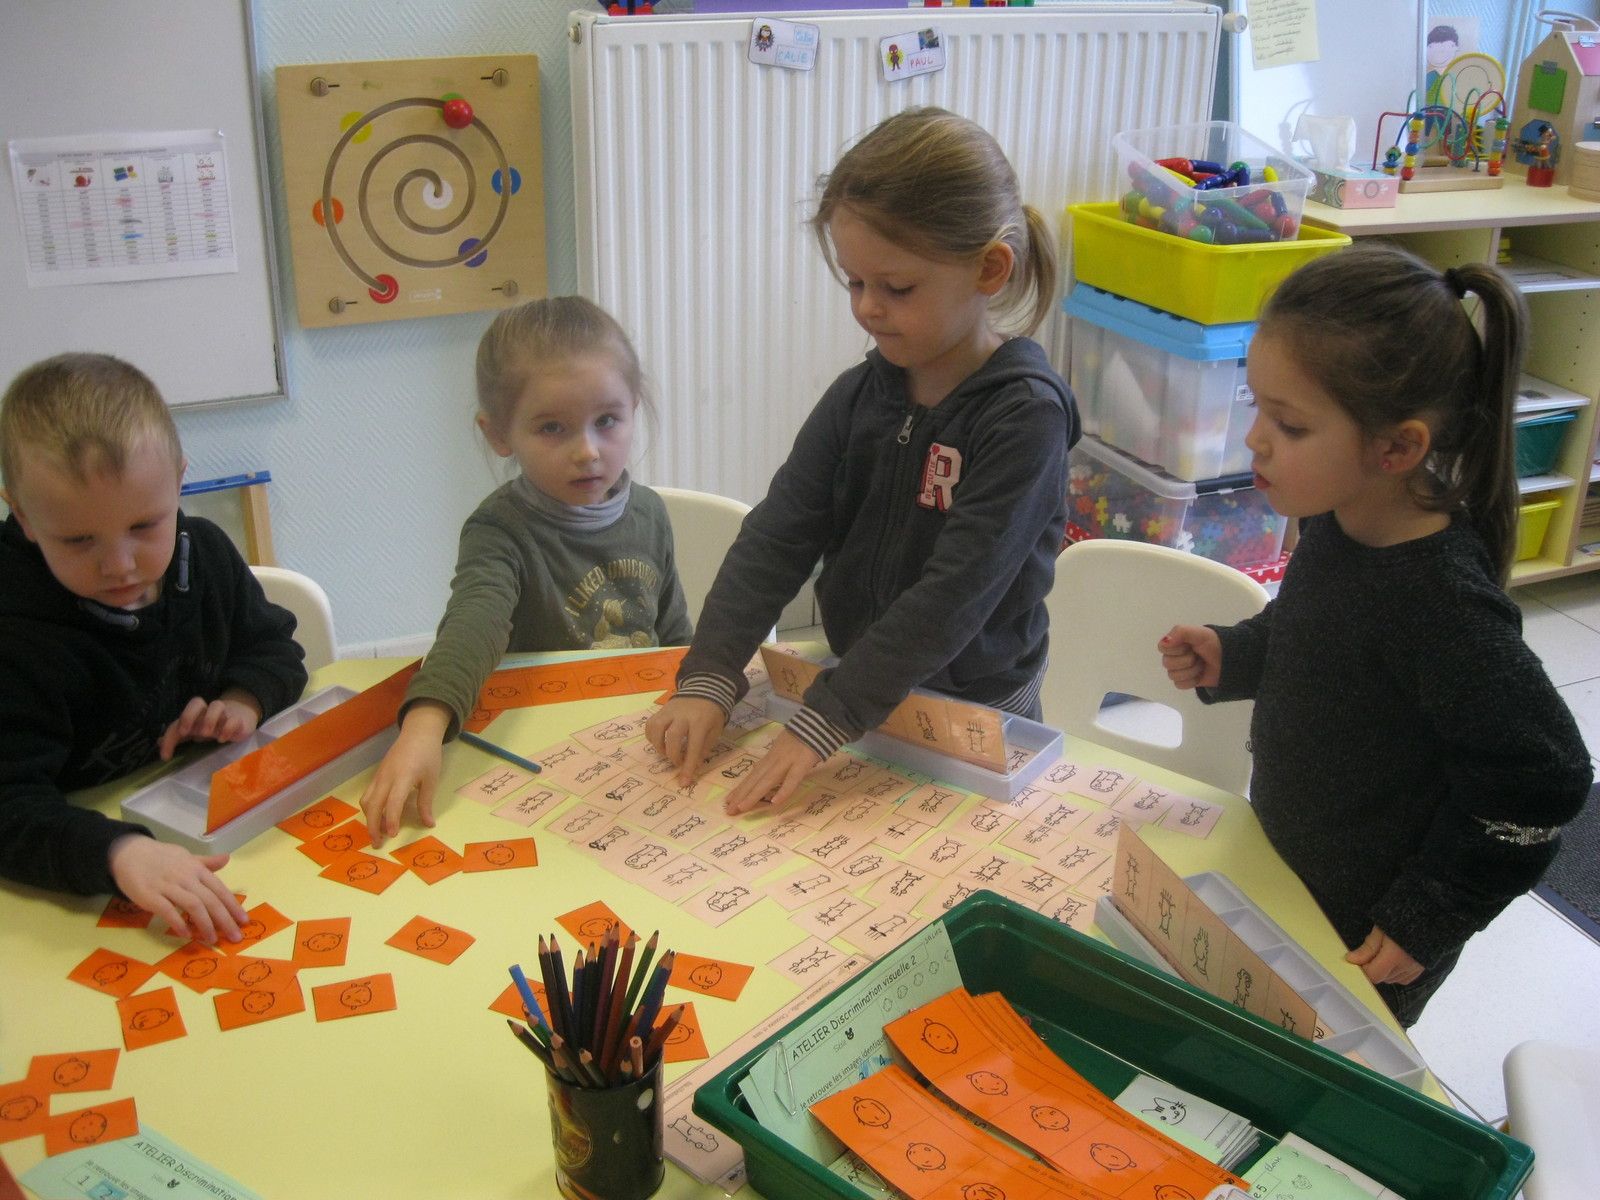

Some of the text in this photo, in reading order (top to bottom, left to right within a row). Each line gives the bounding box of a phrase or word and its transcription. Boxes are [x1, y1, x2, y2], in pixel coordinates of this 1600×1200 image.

[909, 56, 934, 68] PAUL
[915, 441, 963, 512] R
[791, 1024, 832, 1062] ATELIER
[829, 983, 884, 1031] Discrimination
[881, 961, 911, 988] visuelle
[910, 955, 917, 967] 2
[807, 1079, 834, 1107] retrouve
[832, 1070, 844, 1085] les
[841, 1056, 864, 1078] images
[133, 1140, 176, 1168] ATELIER
[1256, 1185, 1268, 1193] 5
